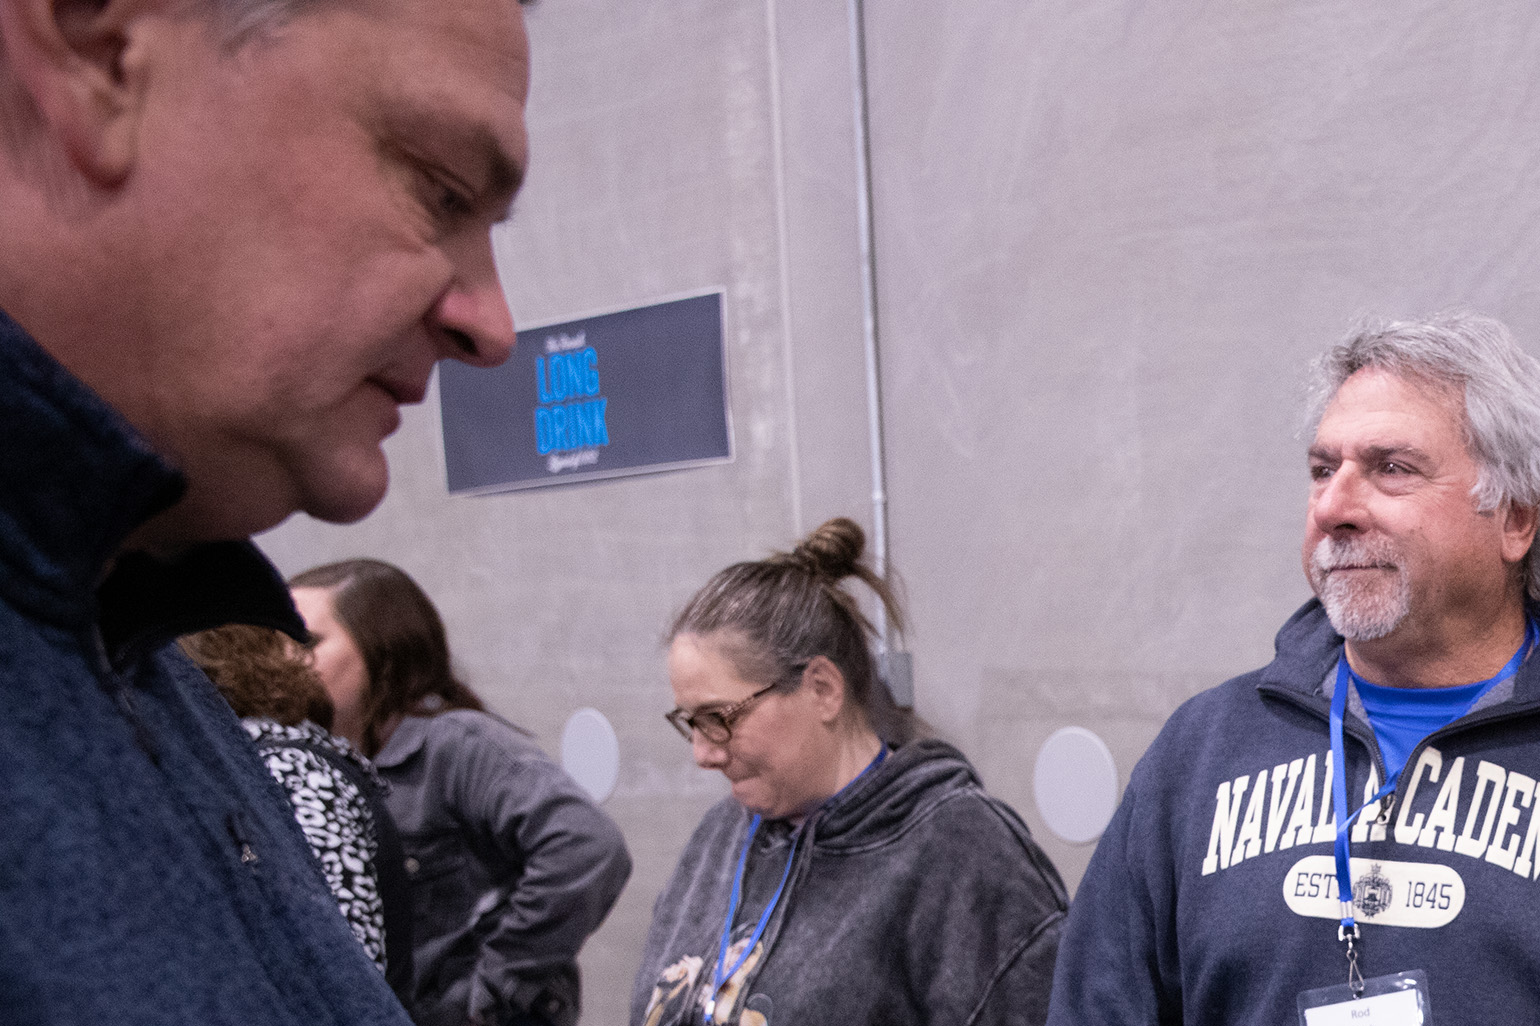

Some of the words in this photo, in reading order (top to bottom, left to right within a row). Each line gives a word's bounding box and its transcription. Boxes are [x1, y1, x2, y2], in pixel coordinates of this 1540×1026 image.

[537, 347, 599, 403] LONG
[535, 398, 609, 454] DRINK
[1201, 748, 1338, 877] NAVAL
[1405, 880, 1453, 911] 1845
[1351, 1008, 1371, 1020] Rod
